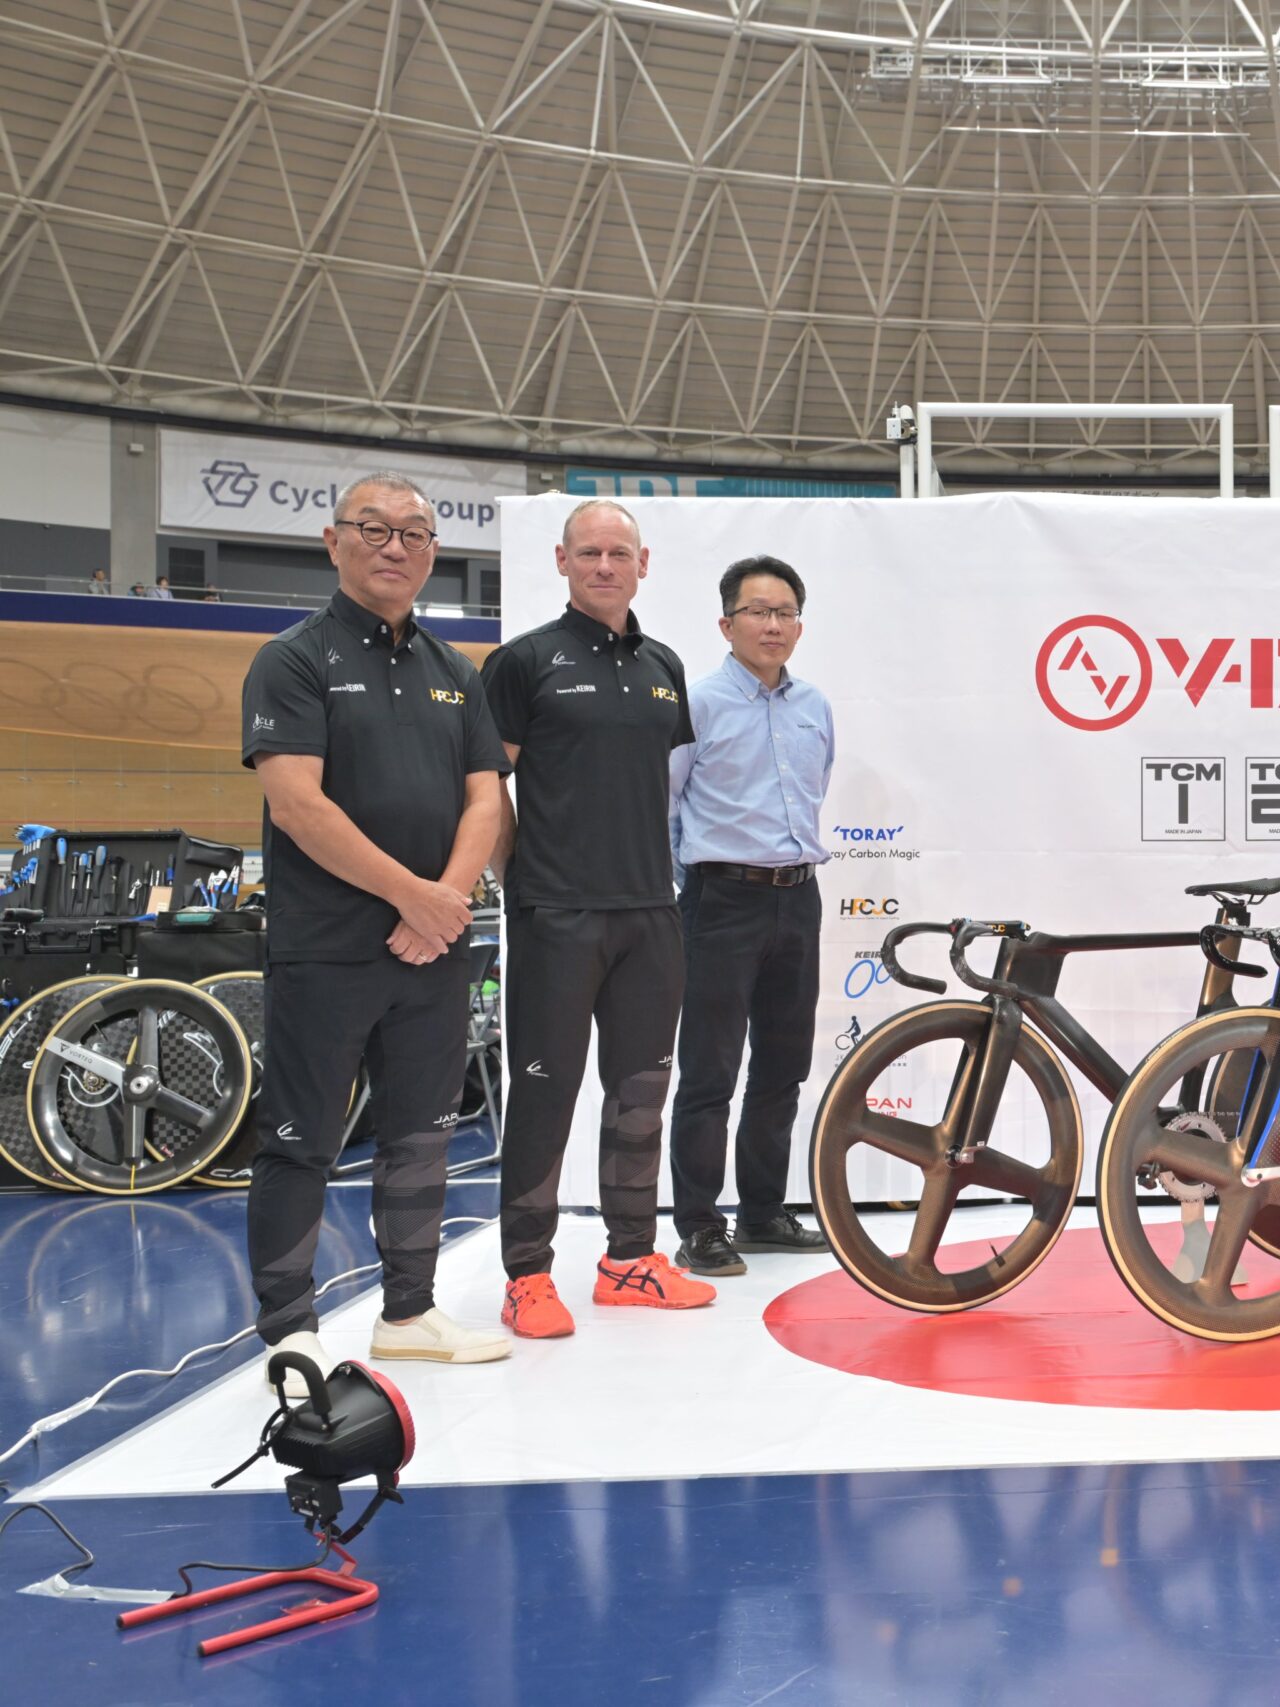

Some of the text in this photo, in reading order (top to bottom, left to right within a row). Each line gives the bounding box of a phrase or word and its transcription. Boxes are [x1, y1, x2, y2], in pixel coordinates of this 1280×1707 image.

[269, 480, 495, 528] Cycl oup
[576, 684, 596, 692] KEIRIN
[1146, 763, 1221, 781] TCM
[831, 848, 920, 861] ray Carbon Magic
[854, 951, 882, 959] KEIR
[866, 1097, 912, 1109] PAN
[433, 1113, 459, 1124] JAP
